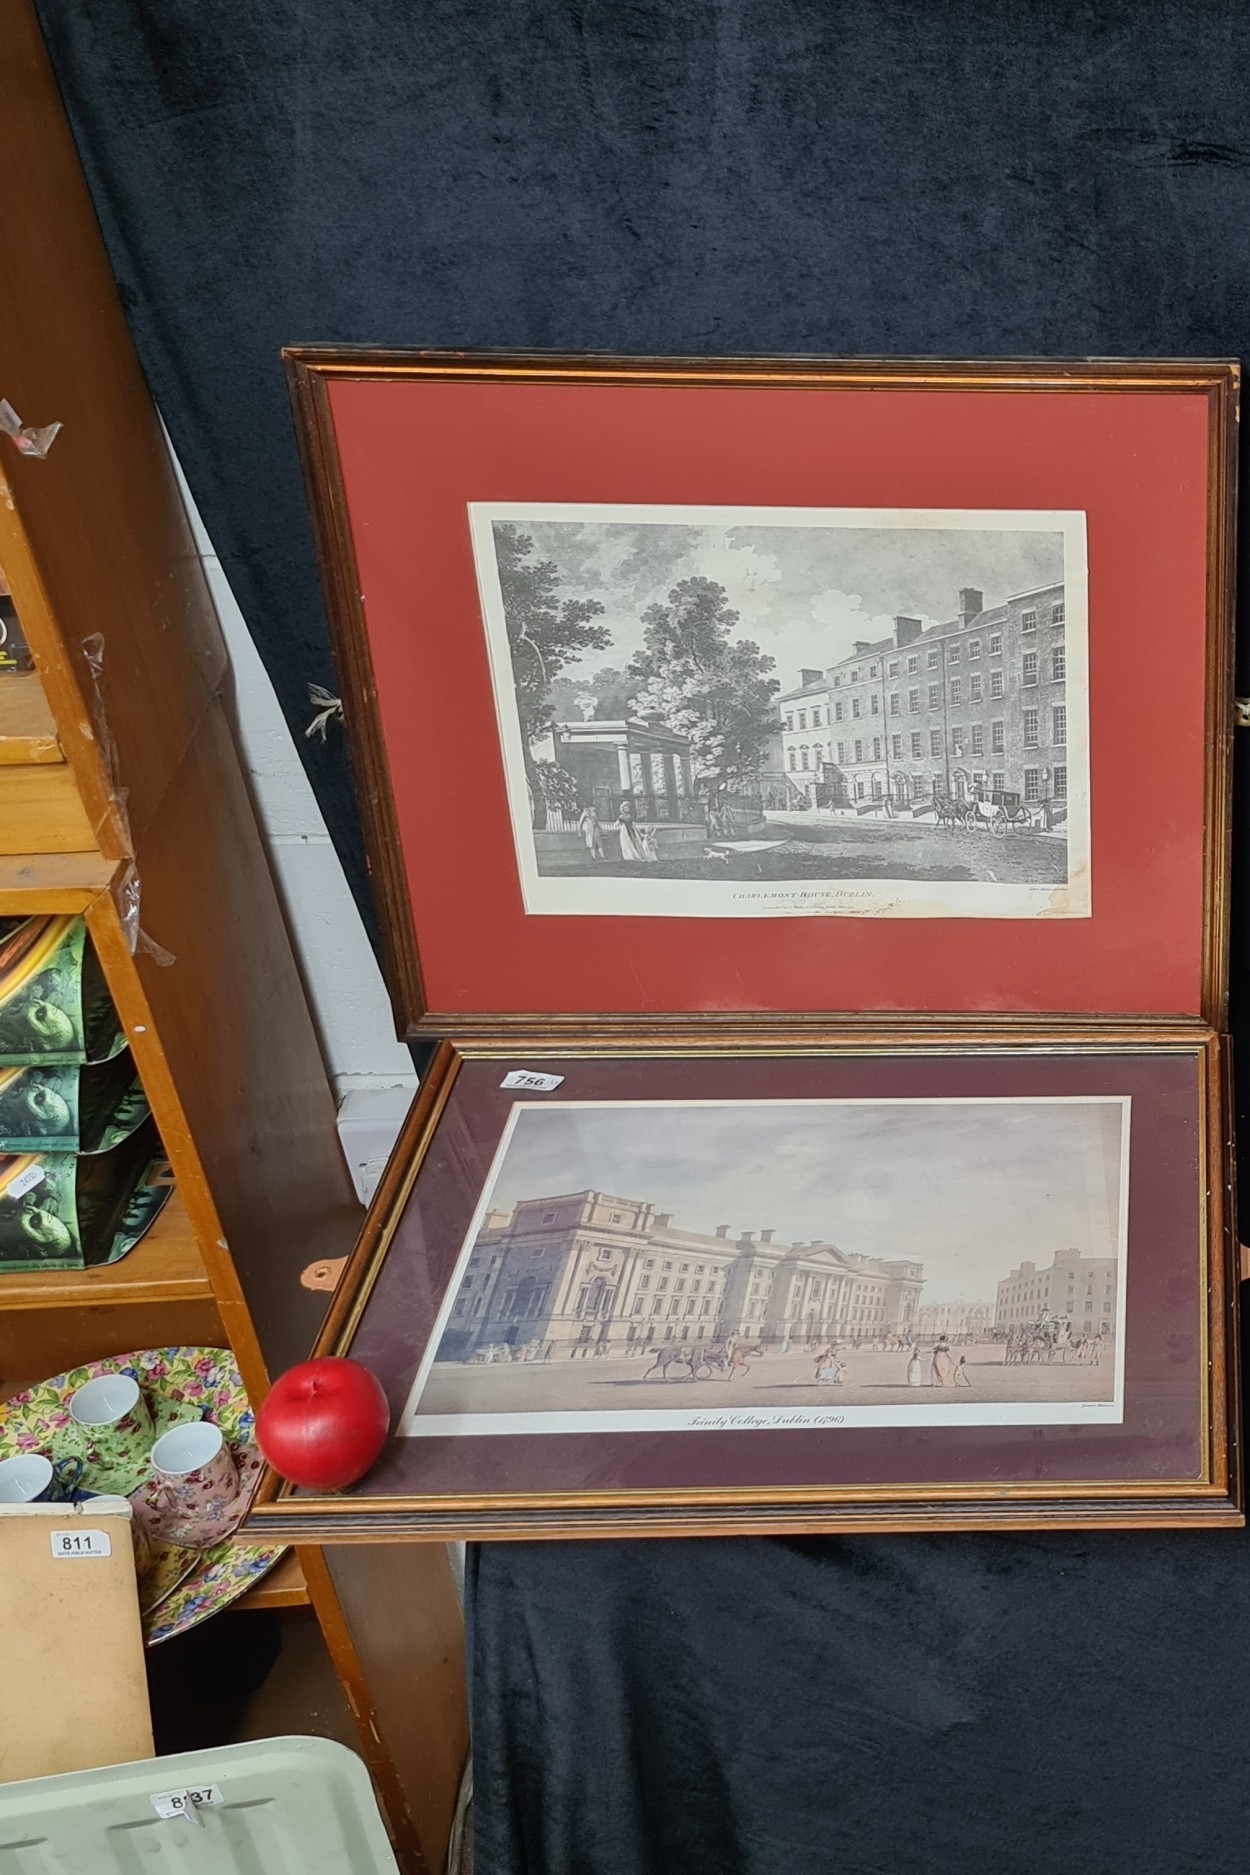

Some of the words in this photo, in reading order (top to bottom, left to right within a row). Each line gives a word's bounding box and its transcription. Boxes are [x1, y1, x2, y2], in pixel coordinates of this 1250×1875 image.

[515, 1074, 546, 1086] 756
[686, 1415, 728, 1428] Trinity
[772, 1413, 811, 1425] Dublin
[813, 1414, 846, 1425] (1796)
[62, 1536, 92, 1551] 811
[171, 1789, 213, 1809] 837
